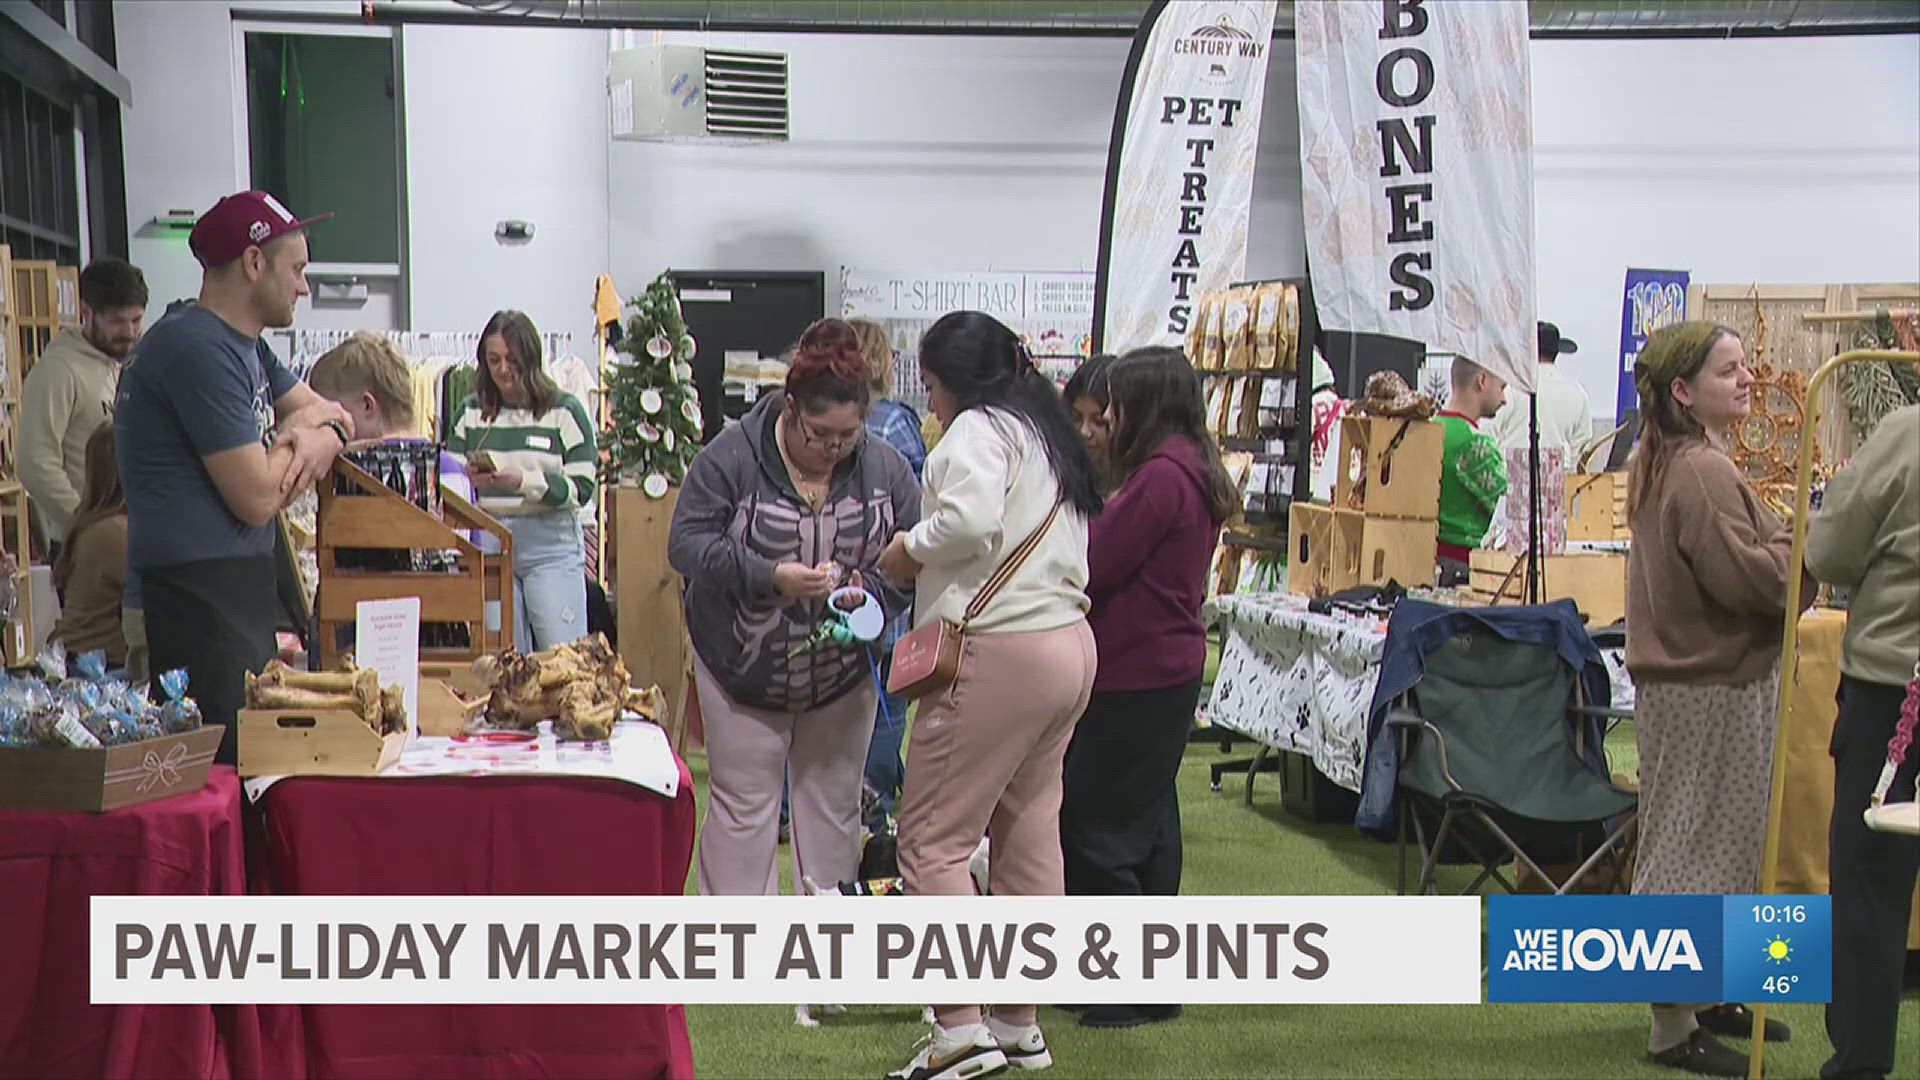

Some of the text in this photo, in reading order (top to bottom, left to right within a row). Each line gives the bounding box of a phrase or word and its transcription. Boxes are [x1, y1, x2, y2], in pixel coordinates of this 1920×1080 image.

[1174, 38, 1264, 58] CENTURY WAY
[1160, 96, 1241, 127] PET
[1376, 0, 1436, 311] BONES
[1167, 139, 1214, 335] TREATS
[889, 280, 973, 312] T-SHIRT
[976, 280, 1017, 312] BAR
